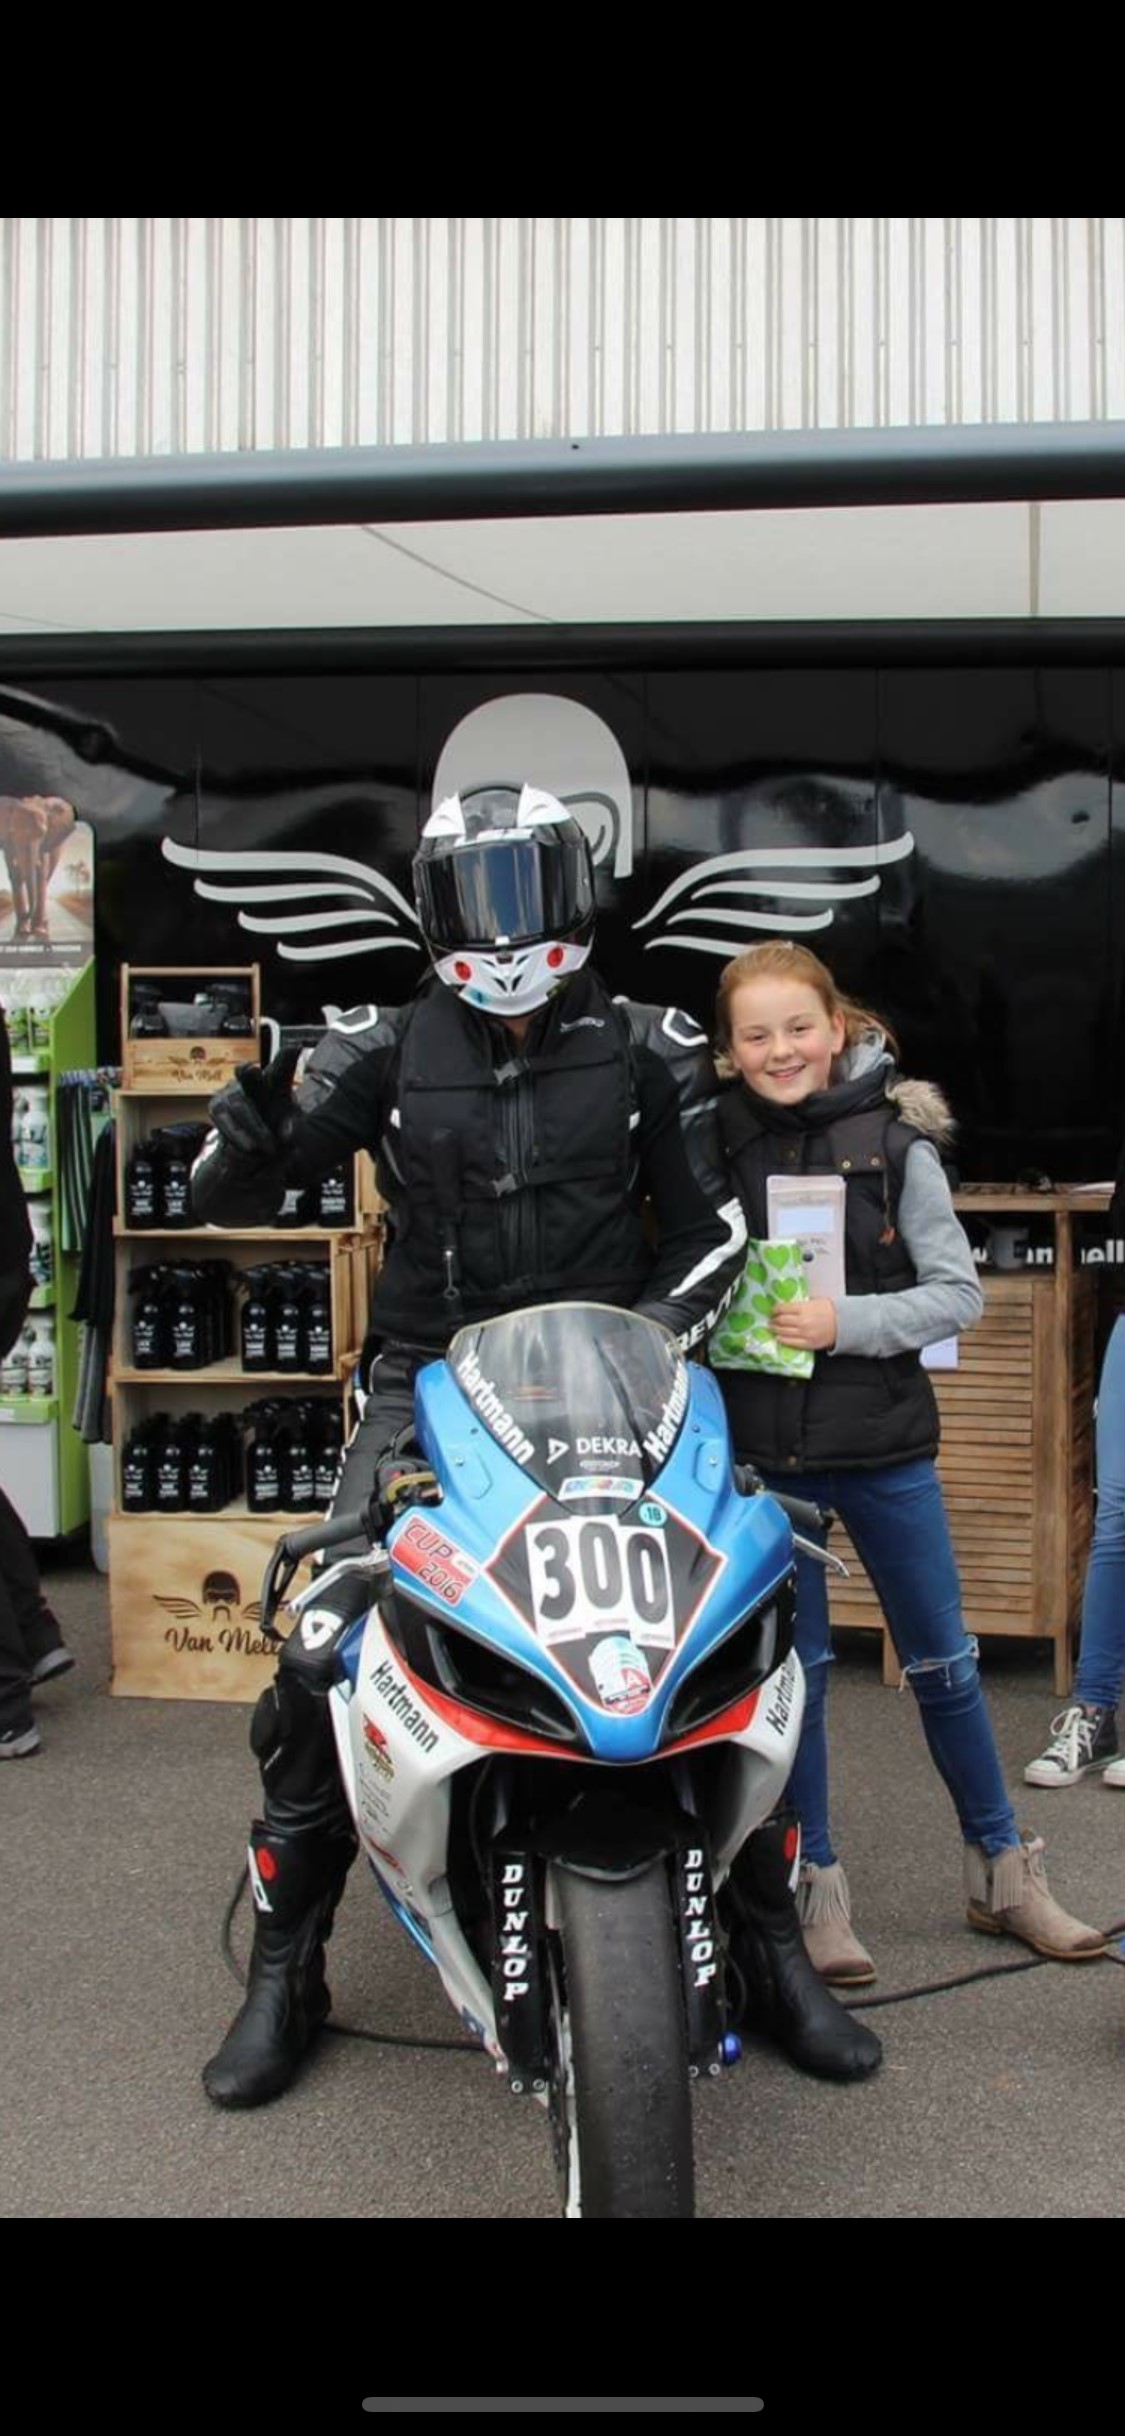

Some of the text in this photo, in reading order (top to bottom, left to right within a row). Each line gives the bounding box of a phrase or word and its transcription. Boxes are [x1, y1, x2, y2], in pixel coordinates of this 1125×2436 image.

[457, 1350, 535, 1465] Hartmann
[576, 1437, 643, 1459] DEKRA
[405, 1525, 452, 1558] CUP
[419, 1562, 463, 1598] 2016
[534, 1522, 669, 1624] 300
[165, 1627, 213, 1652] Van
[370, 1660, 439, 1753] Hartmann
[501, 1864, 529, 2001] DUNLOP
[685, 1849, 717, 1987] DUNLOP
